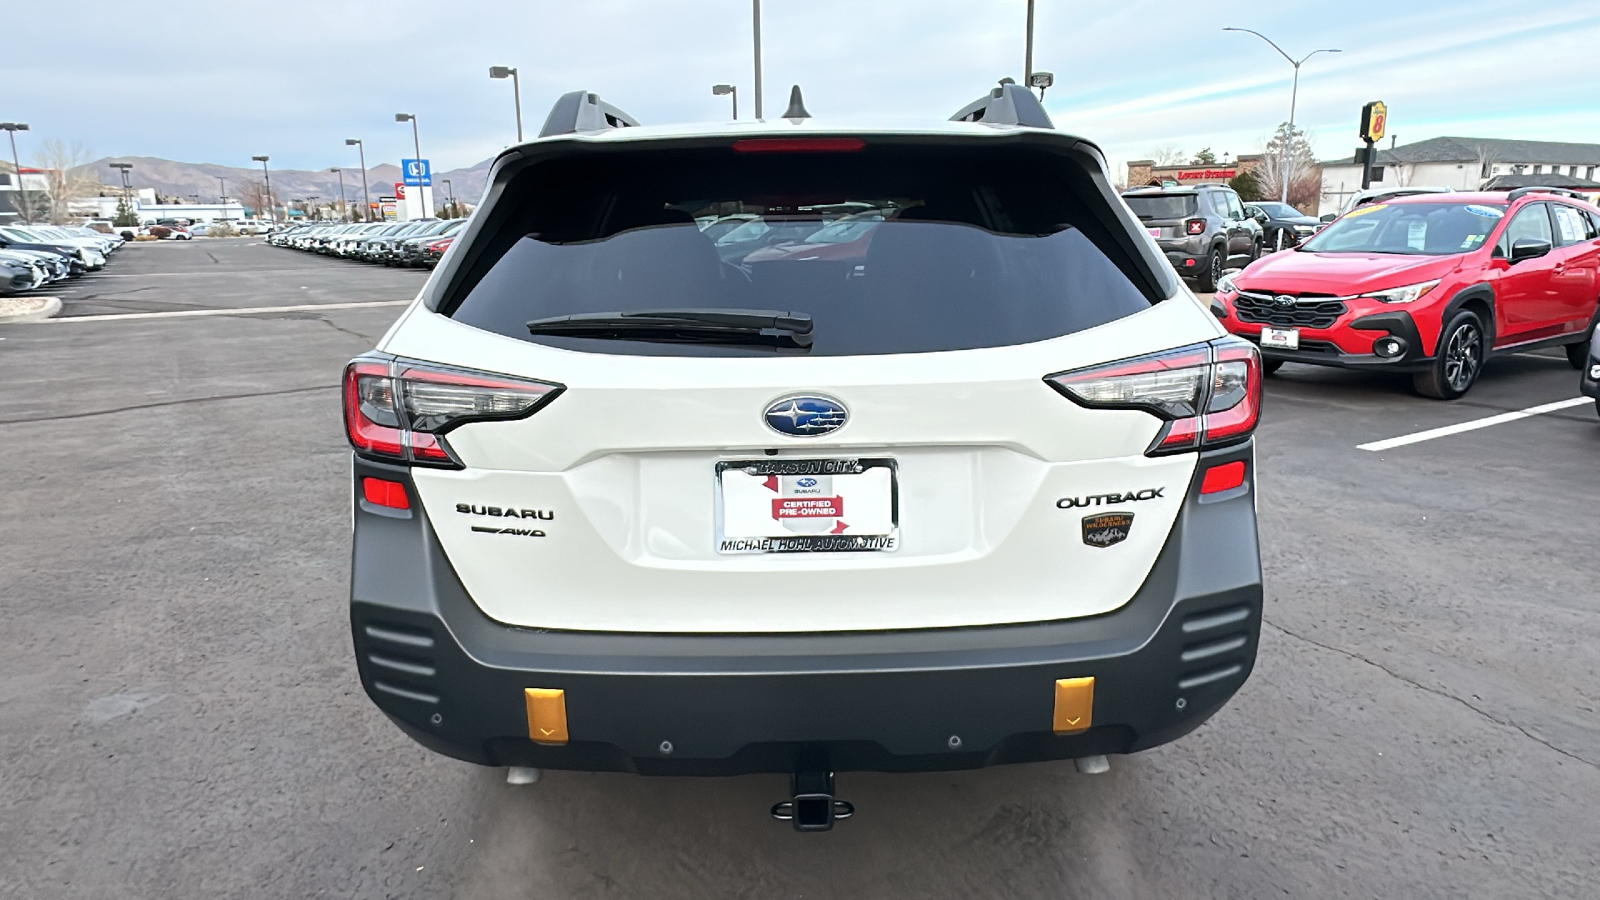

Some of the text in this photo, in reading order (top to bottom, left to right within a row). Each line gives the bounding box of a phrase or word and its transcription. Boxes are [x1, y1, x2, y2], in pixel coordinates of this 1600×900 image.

[1373, 115, 1384, 133] 8
[824, 460, 857, 474] CITY
[783, 500, 831, 508] CERTIFIED
[1056, 487, 1165, 509] OUTBACK
[456, 503, 554, 520] SUBARU
[779, 507, 836, 515] PRE-OWNED
[498, 527, 546, 537] AWD
[720, 537, 894, 551] MICHAEL HOHL AUTOMOTIVE
